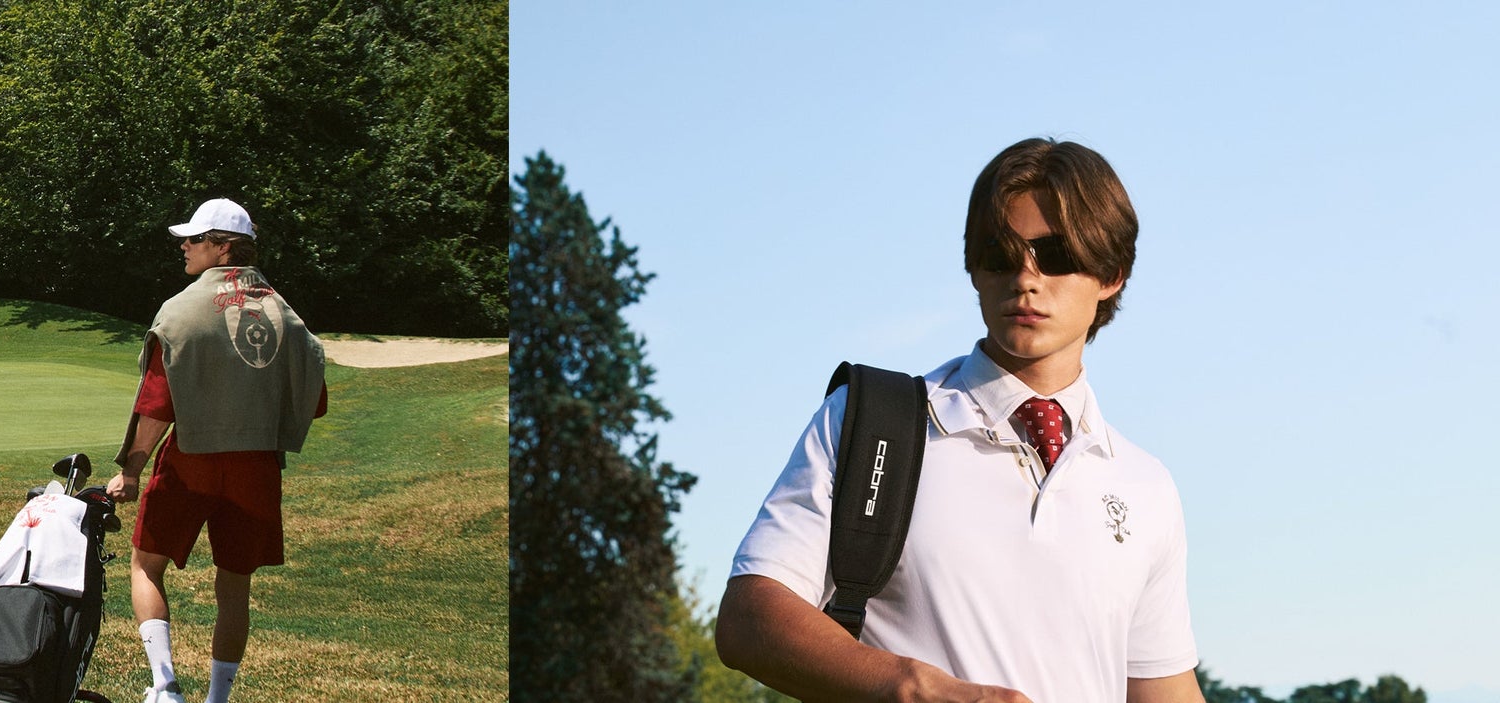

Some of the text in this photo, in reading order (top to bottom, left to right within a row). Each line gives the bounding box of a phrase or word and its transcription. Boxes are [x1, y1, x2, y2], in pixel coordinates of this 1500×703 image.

[216, 281, 234, 294] AC
[237, 274, 263, 289] MIL
[213, 288, 247, 314] Golf
[864, 439, 888, 516] cobra
